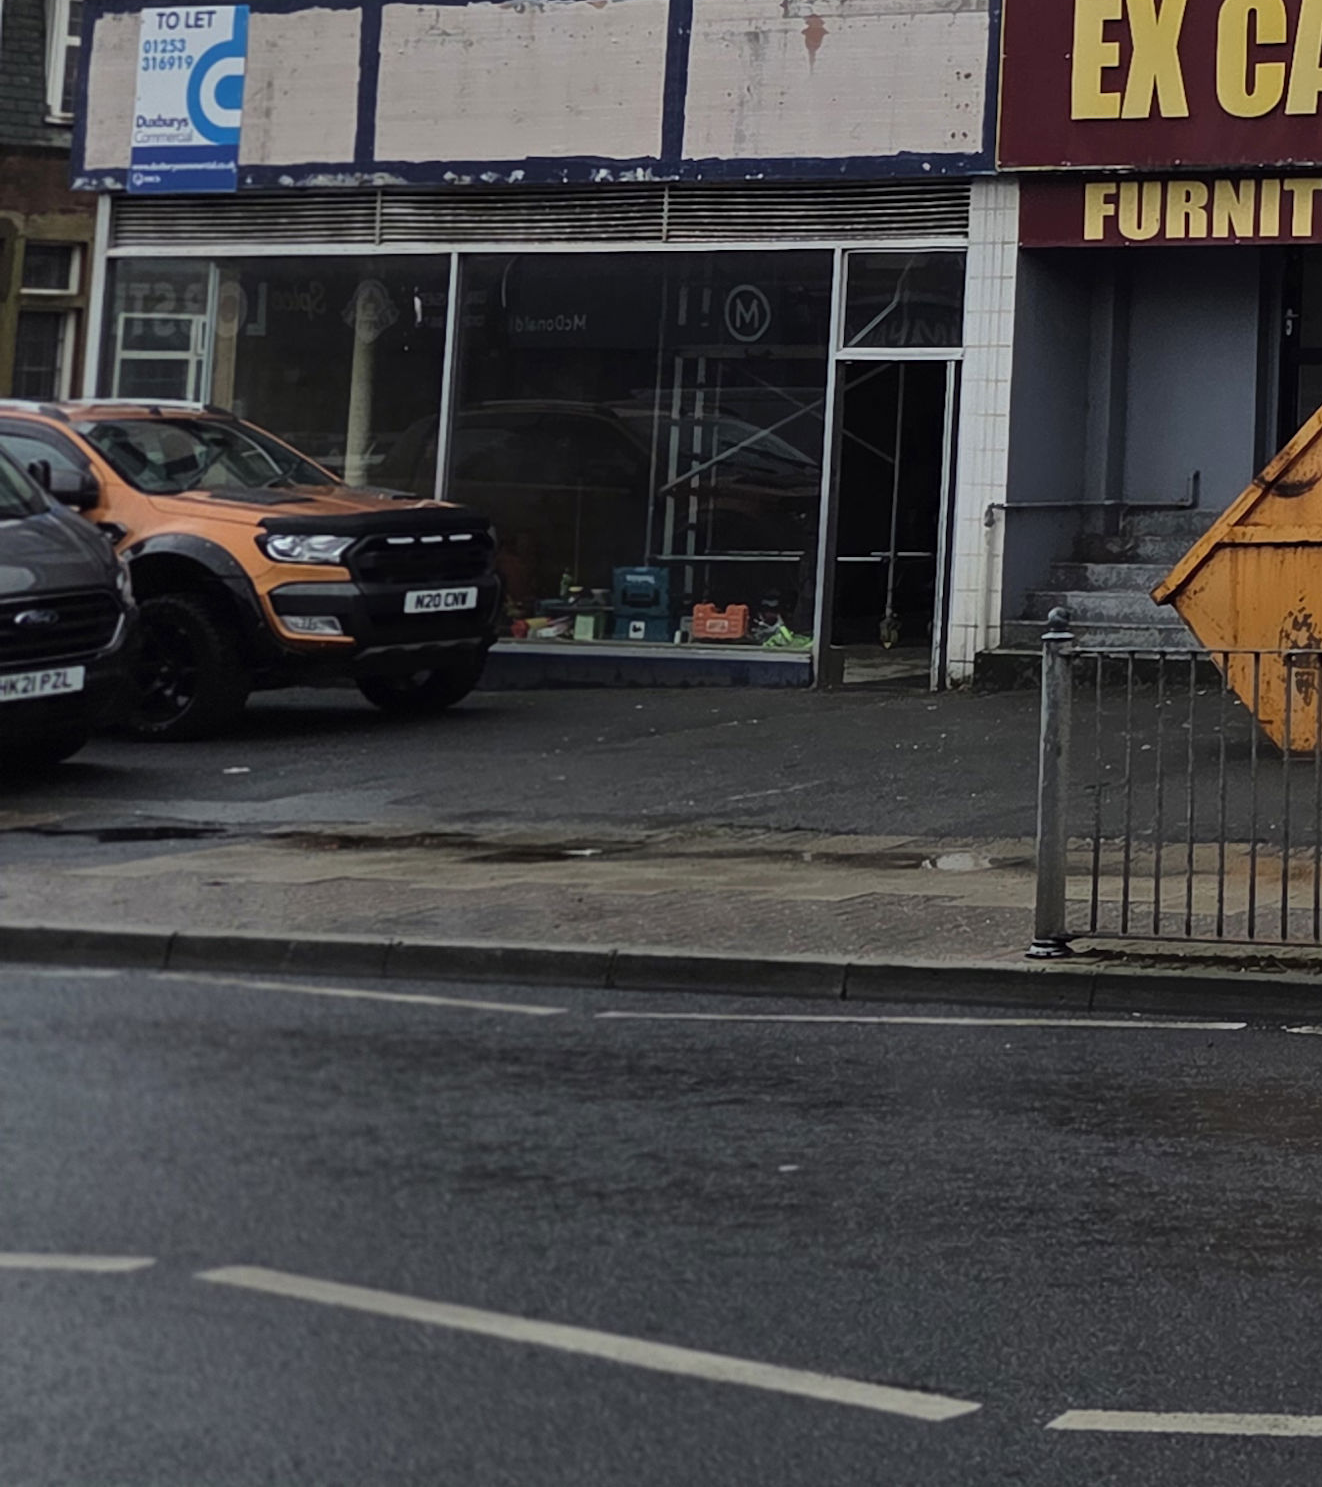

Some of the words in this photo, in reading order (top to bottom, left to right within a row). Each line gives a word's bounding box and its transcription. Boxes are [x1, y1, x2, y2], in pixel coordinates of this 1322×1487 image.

[156, 12, 180, 29] TO
[185, 10, 216, 28] LET
[143, 39, 186, 54] 01253
[142, 55, 194, 71] 316919
[415, 594, 441, 610] N20
[41, 671, 73, 690] PZL
